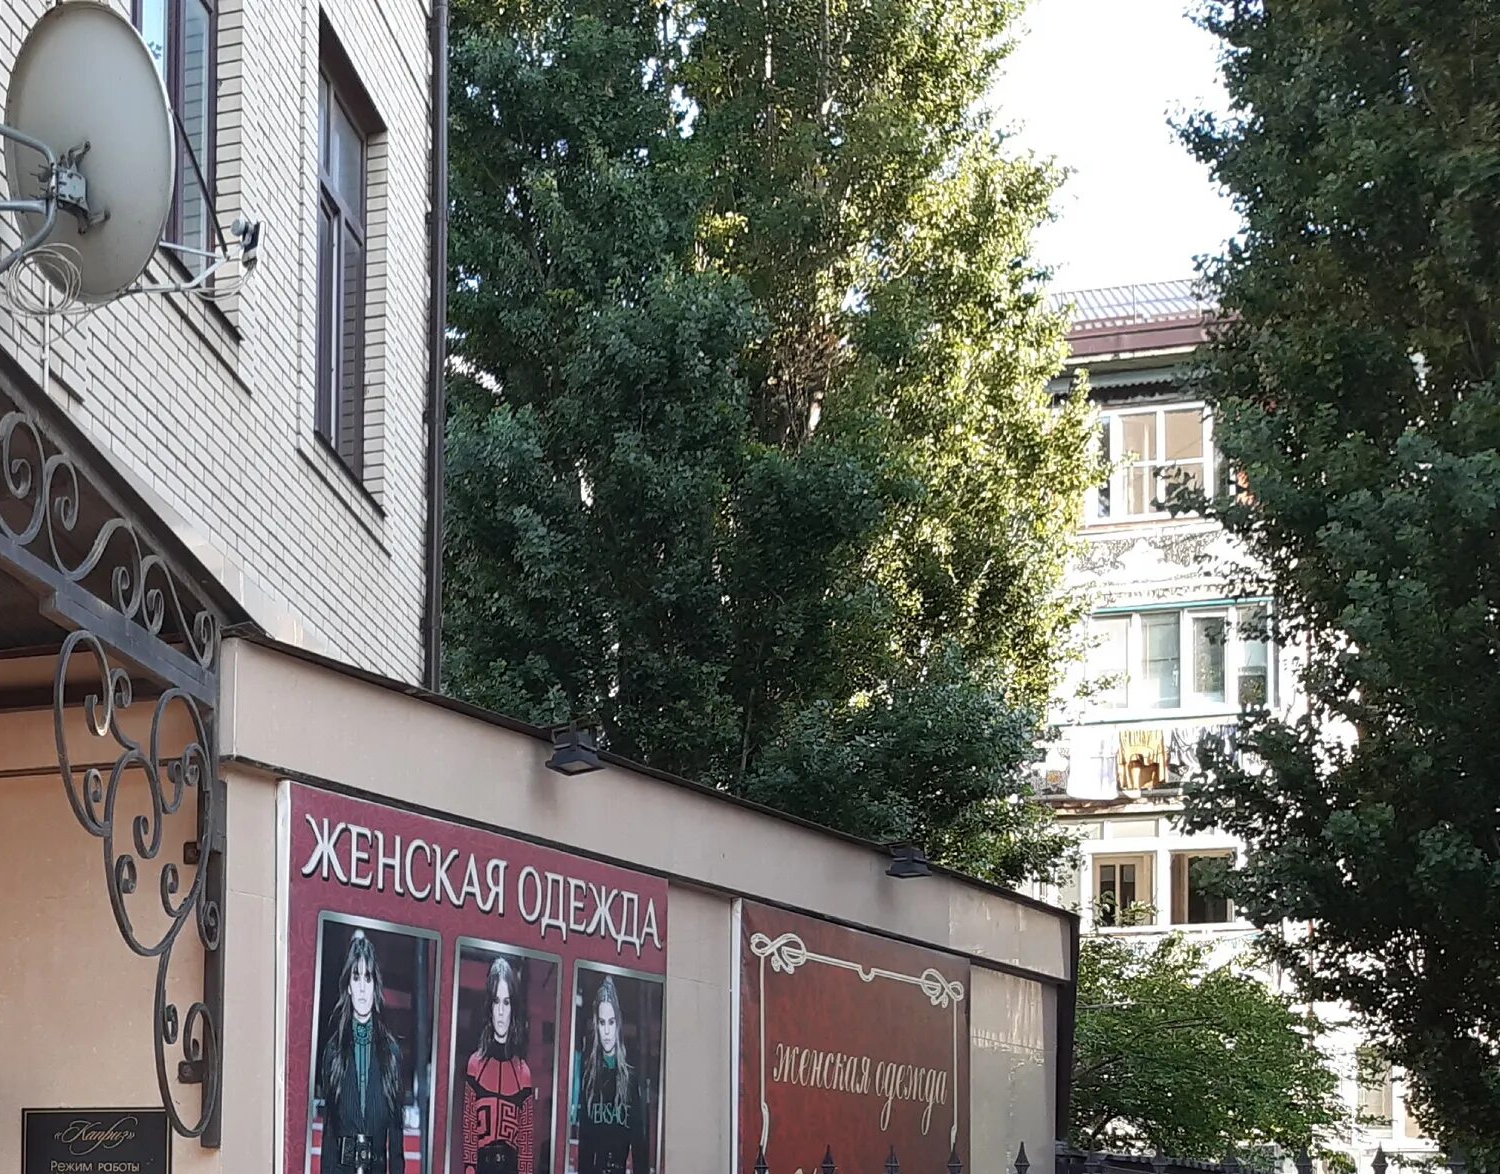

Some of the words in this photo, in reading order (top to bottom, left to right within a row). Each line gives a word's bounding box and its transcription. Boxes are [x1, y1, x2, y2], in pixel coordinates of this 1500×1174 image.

[301, 814, 508, 914] ЖЕНСКАЯ
[517, 865, 664, 956] ОДЕЖДА
[773, 1043, 872, 1095] женская
[875, 1061, 947, 1136] одежда
[50, 1160, 93, 1172] Режим
